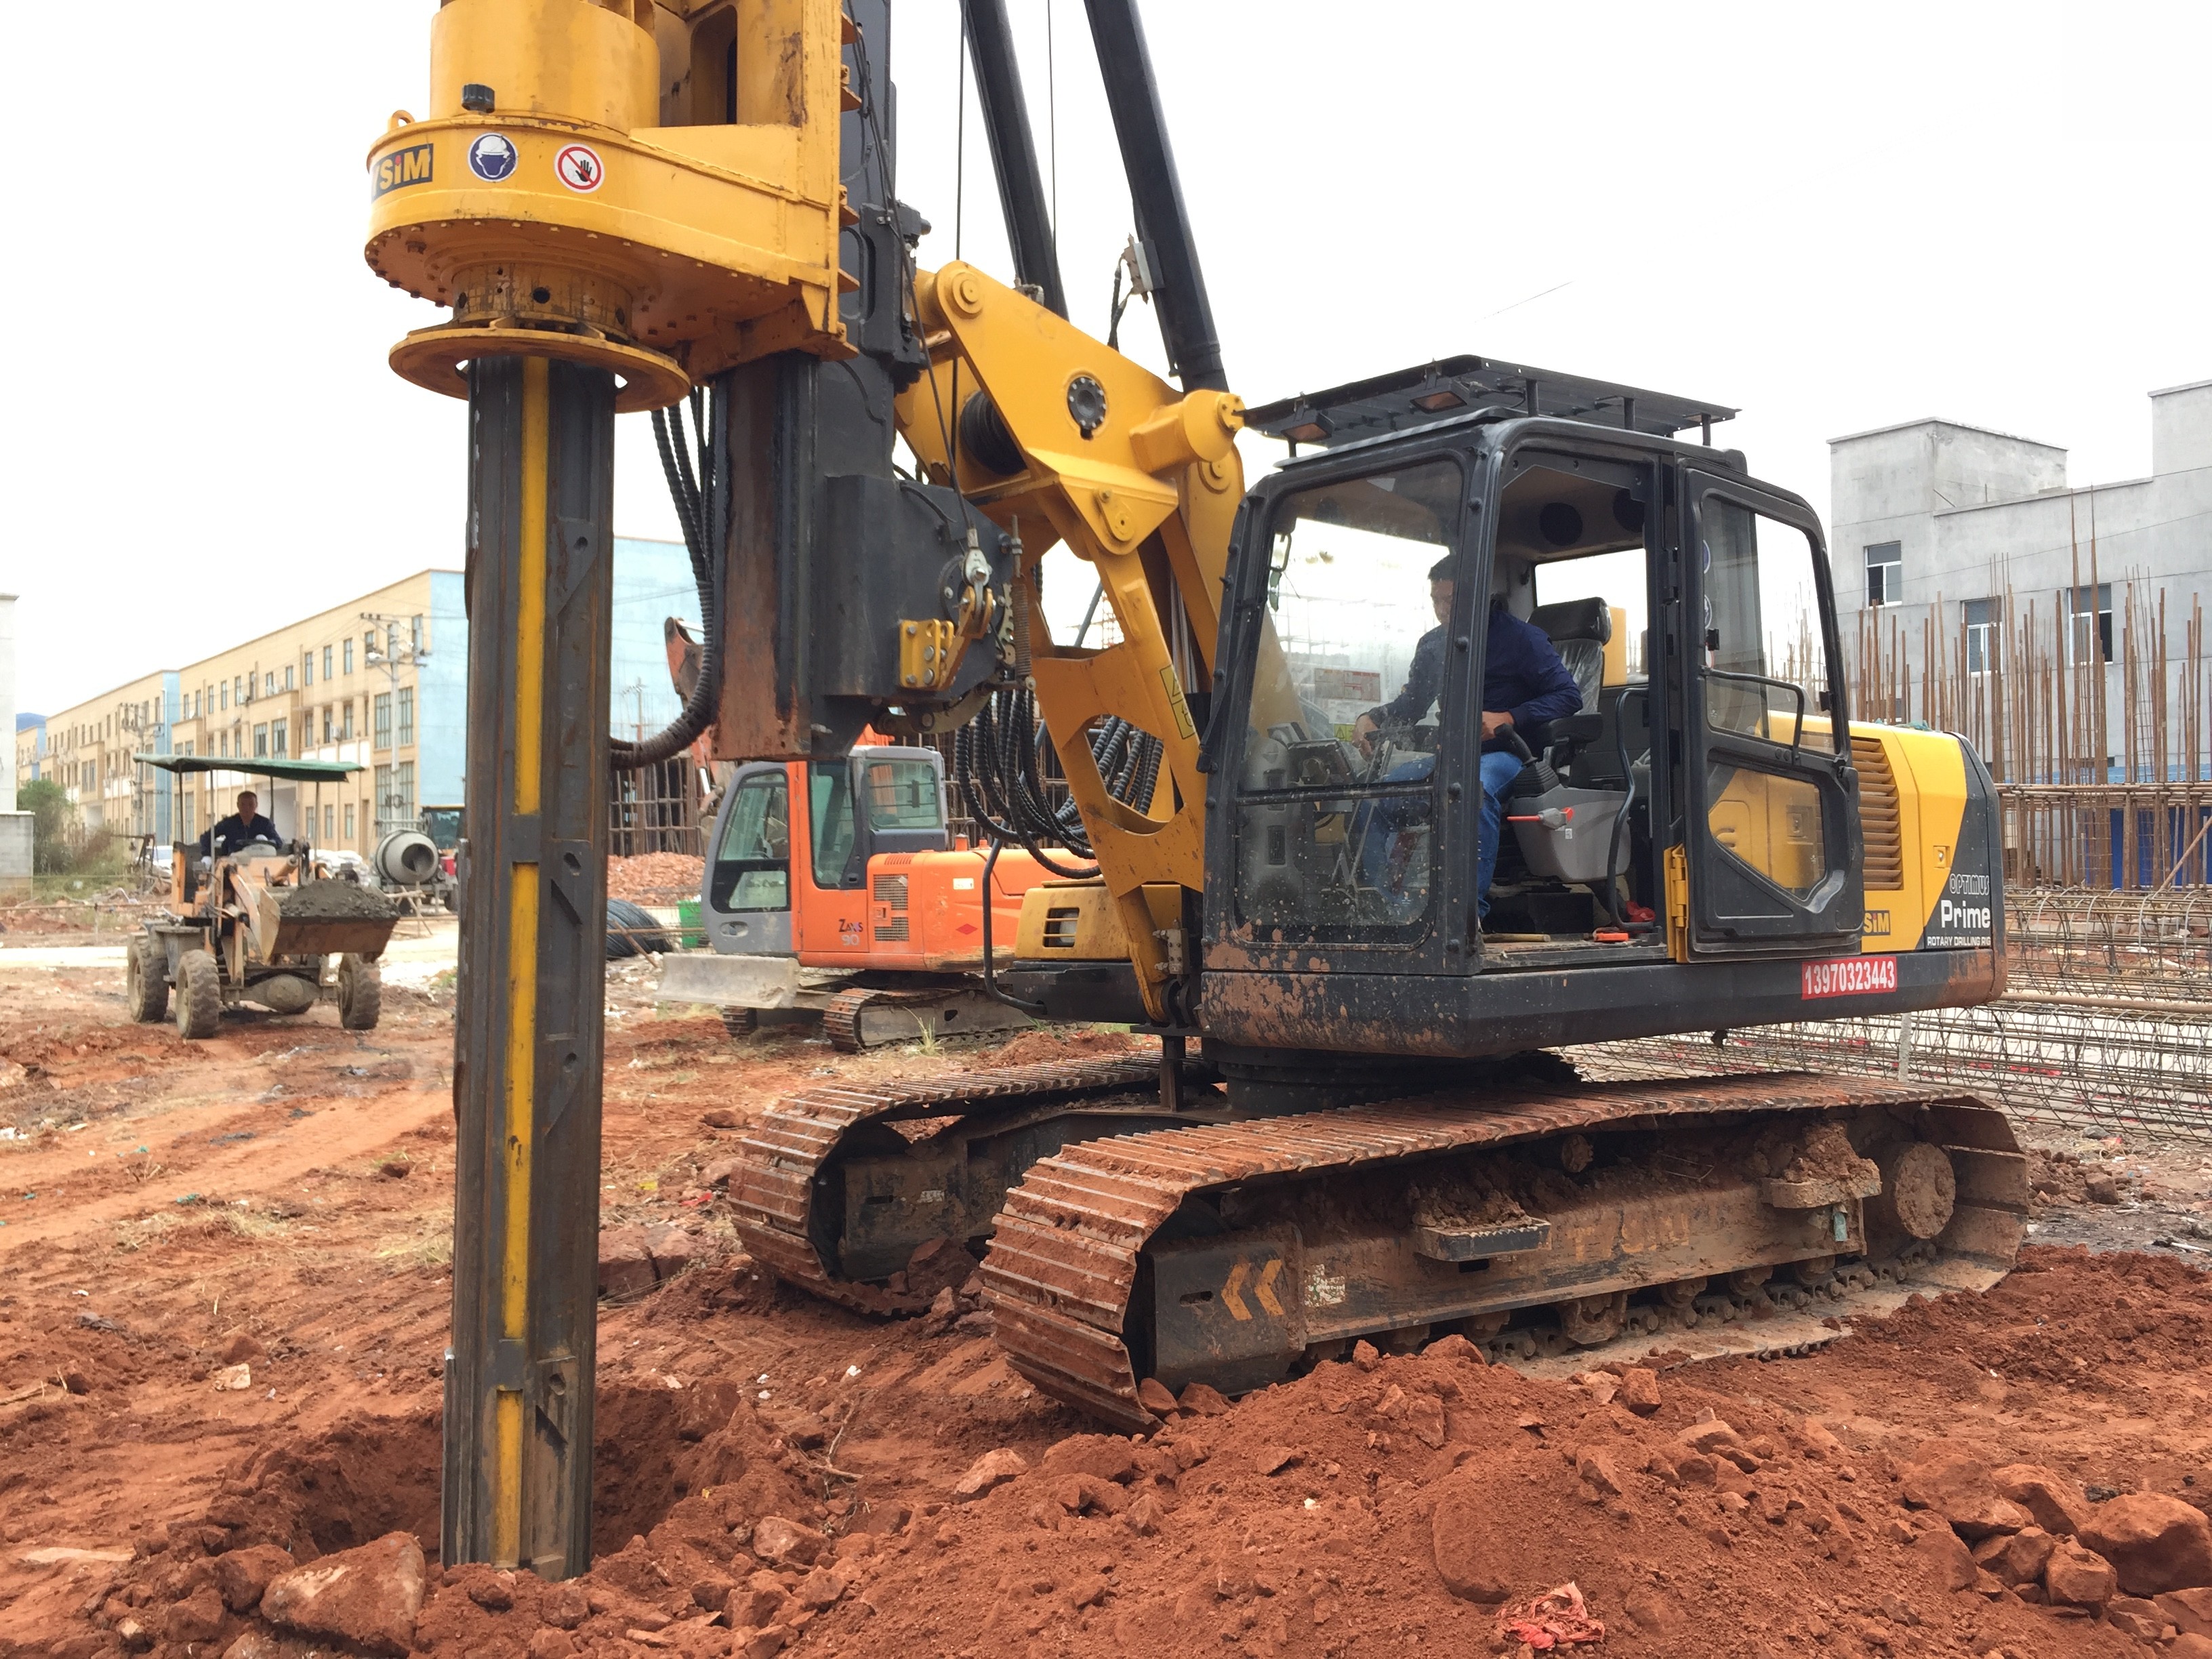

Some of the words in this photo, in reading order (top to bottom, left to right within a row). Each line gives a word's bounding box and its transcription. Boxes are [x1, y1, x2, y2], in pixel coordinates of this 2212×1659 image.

[1949, 873, 1990, 895] OPTIMUS
[1941, 900, 1991, 928] Prime
[841, 934, 860, 947] 90
[1927, 936, 1952, 946] ROTARY
[1954, 936, 1980, 946] DRILLING
[1981, 936, 1991, 946] RIG
[1805, 960, 1895, 995] 13970323443
